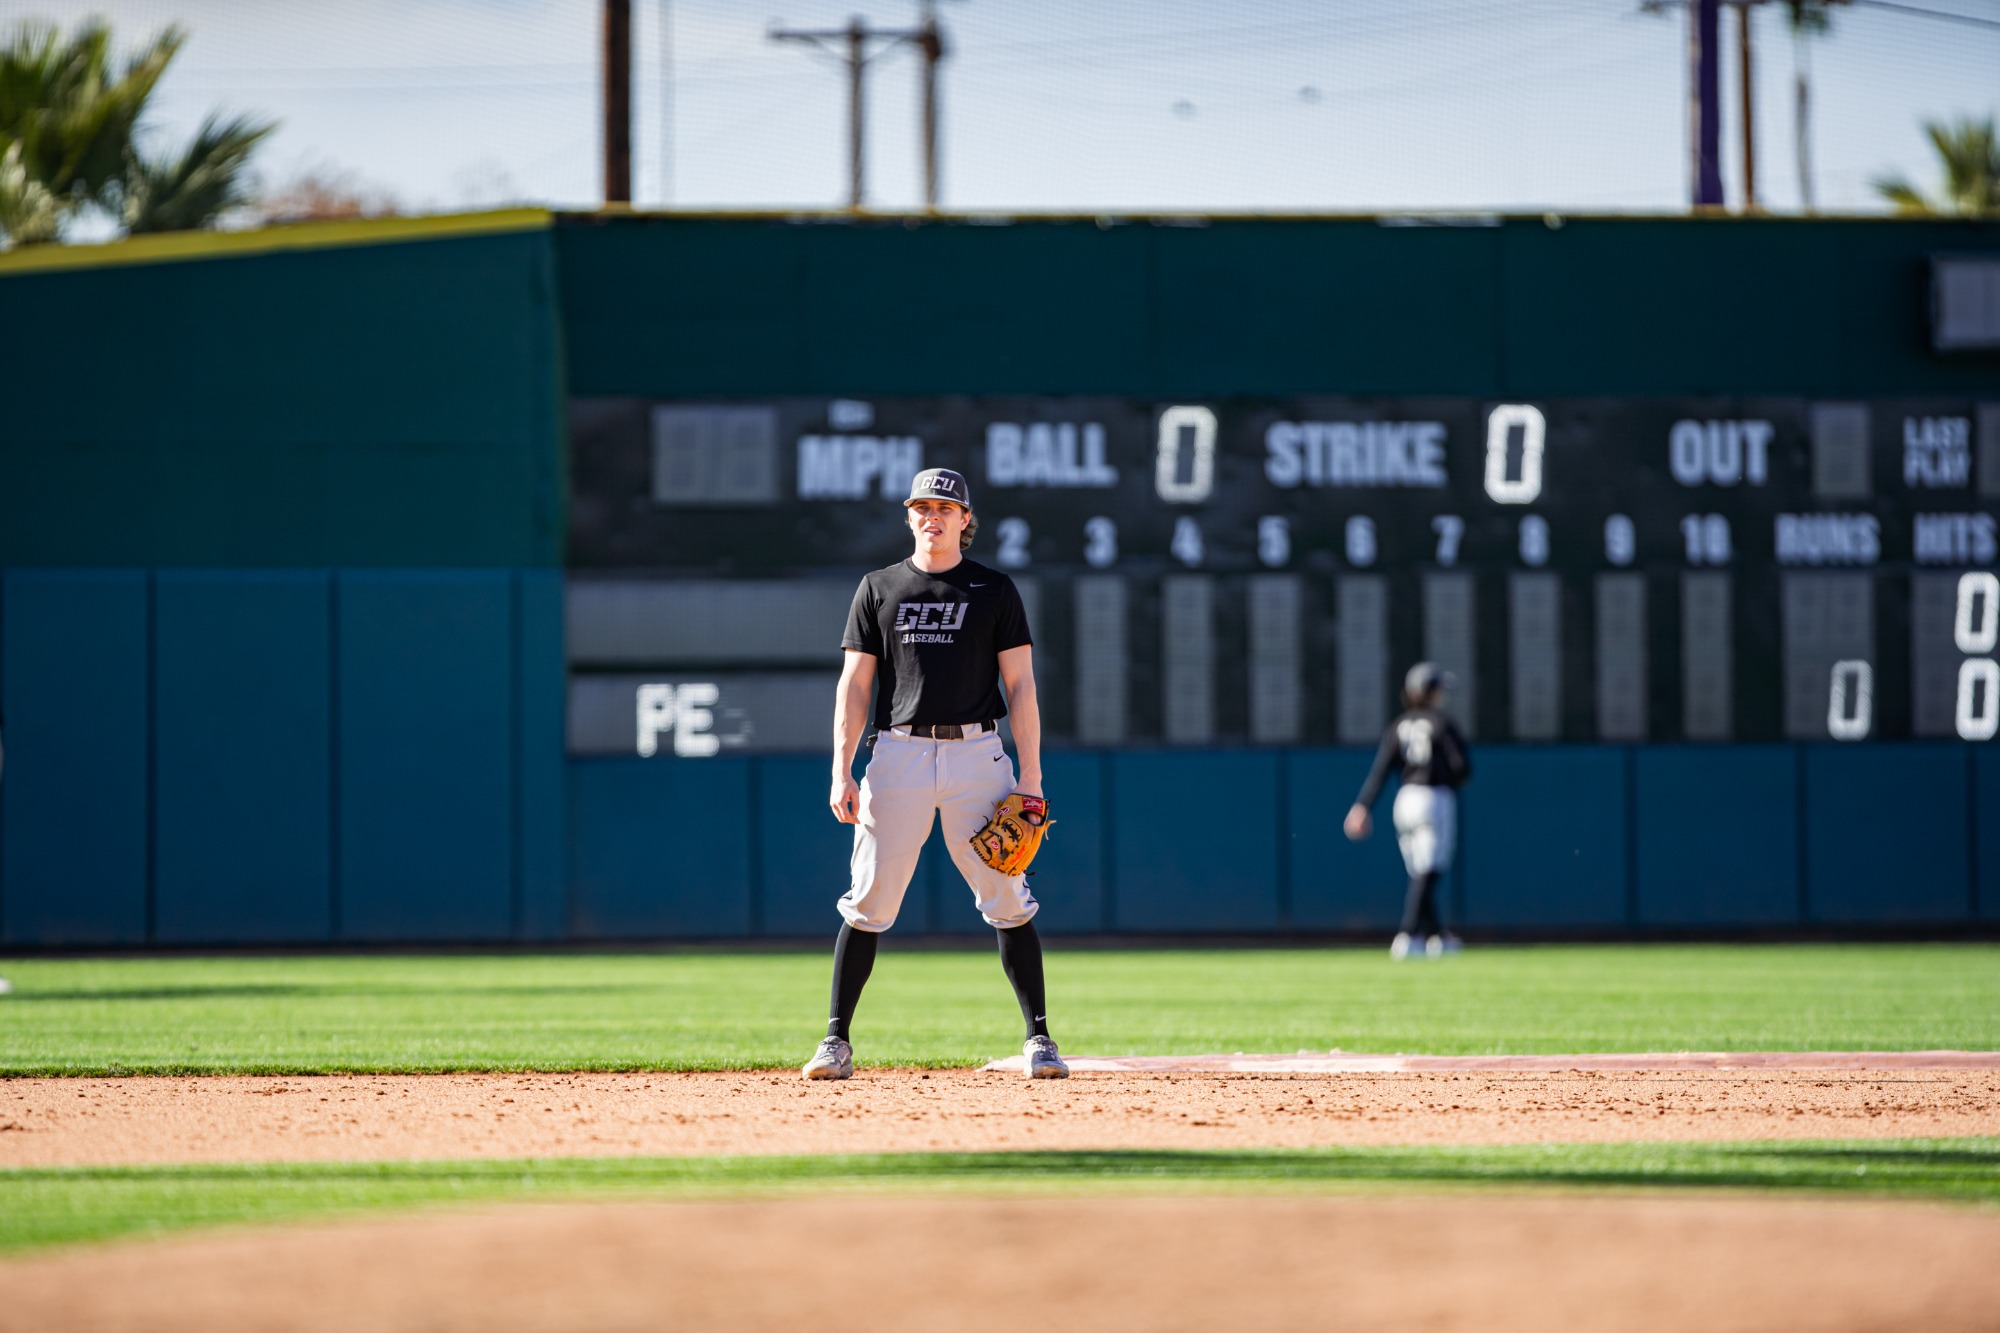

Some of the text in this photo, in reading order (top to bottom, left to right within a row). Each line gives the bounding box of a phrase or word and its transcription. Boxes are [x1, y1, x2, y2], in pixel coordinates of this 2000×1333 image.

[985, 421, 1117, 488] BALL
[1156, 405, 1217, 502] 0
[1264, 421, 1448, 488] STRIKE
[1484, 404, 1546, 504] 0
[1669, 419, 1774, 488] OUT
[1904, 416, 1970, 446] LAST
[798, 435, 922, 498] MPH
[920, 476, 956, 492] GCU
[997, 512, 1998, 568] 2 3 4 5 6 7 8 9 10 RUNS HITS
[895, 602, 969, 631] GCU
[901, 633, 954, 644] BASEBALL
[1954, 571, 2000, 654] 0
[1827, 659, 1873, 742] 0
[1955, 657, 2000, 742] 0
